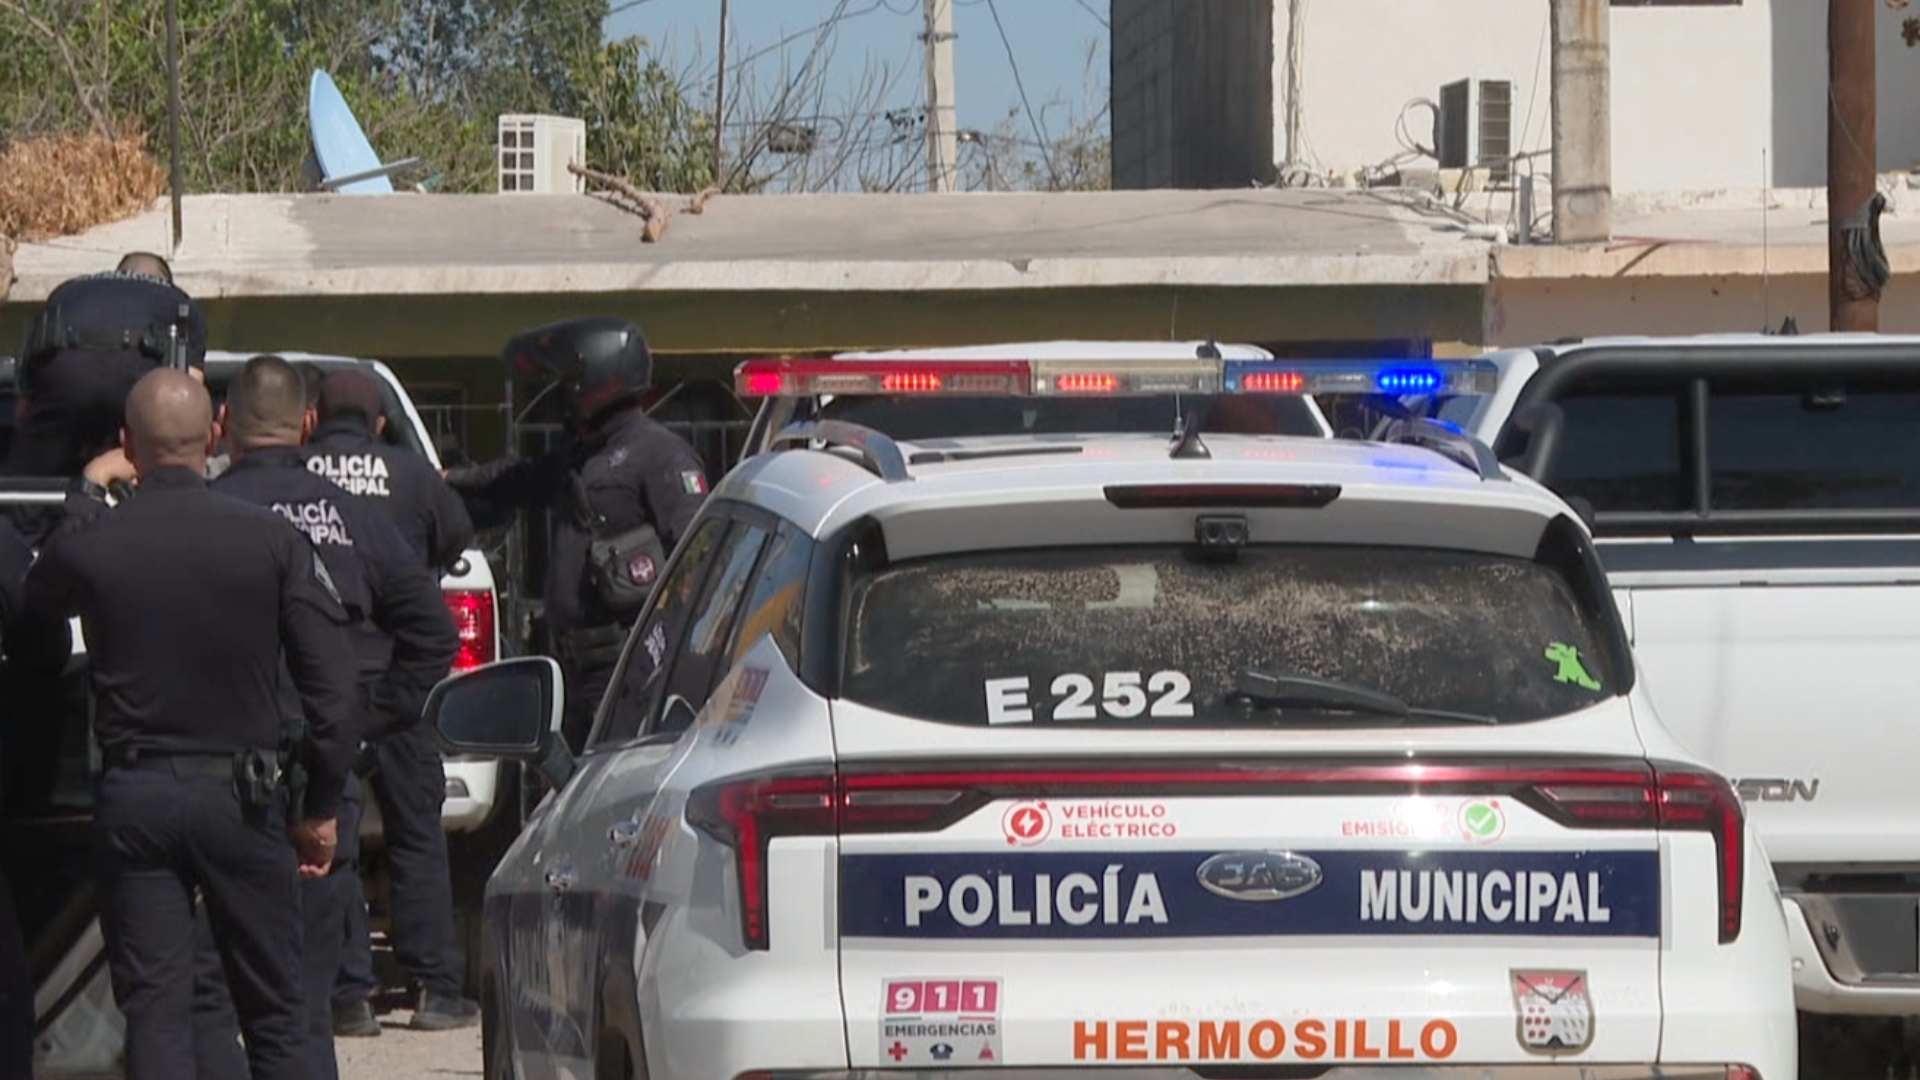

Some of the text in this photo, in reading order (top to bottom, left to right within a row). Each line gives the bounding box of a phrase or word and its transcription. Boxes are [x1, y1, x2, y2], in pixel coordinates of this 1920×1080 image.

[306, 453, 389, 478] OLICÍA
[331, 477, 390, 496] CIPAL
[984, 670, 1194, 725] E 252
[1731, 778, 1819, 802] SON
[1062, 801, 1166, 818] VEHÍCULO
[1062, 821, 1176, 838] ELÉCTRICO
[904, 864, 1611, 927] POLICÍA MUNICIPAL
[894, 985, 987, 1011] 911
[884, 1023, 997, 1037] EMERGENCIAS
[1073, 1019, 1458, 1060] HERMOSILLO
